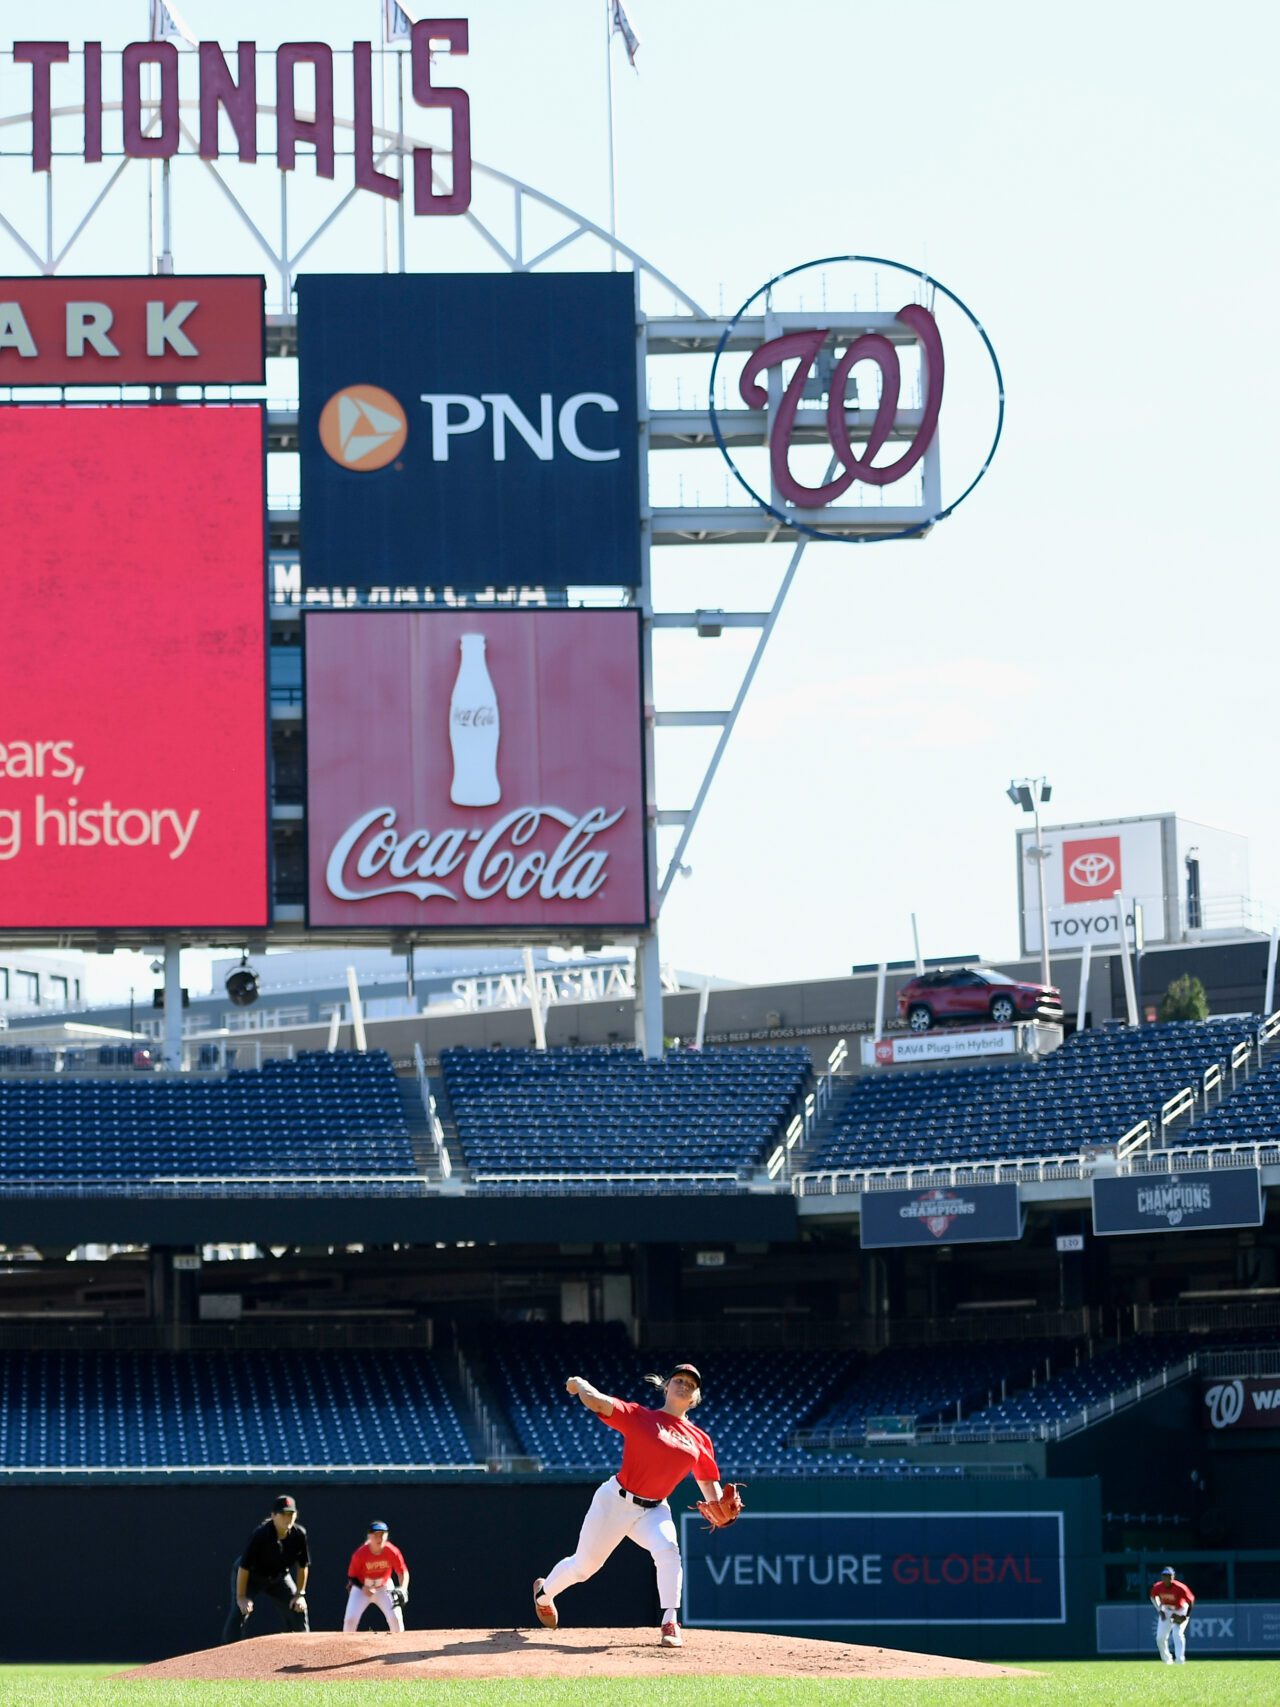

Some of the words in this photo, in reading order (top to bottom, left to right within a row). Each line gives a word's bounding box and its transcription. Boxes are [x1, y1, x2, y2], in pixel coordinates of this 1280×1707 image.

[740, 303, 945, 508] W
[421, 393, 621, 462] PNC
[35, 796, 200, 860] history
[325, 806, 626, 901] Coca-Cola
[897, 1045, 924, 1056] RAV4
[968, 1037, 1004, 1050] Hybrid
[899, 1203, 976, 1218] CHAMPIONS
[1137, 1187, 1211, 1213] CHAMPIONS
[705, 1554, 882, 1585] VENTURE
[892, 1553, 1042, 1585] GLOBAL
[1190, 1617, 1234, 1638] RTX
